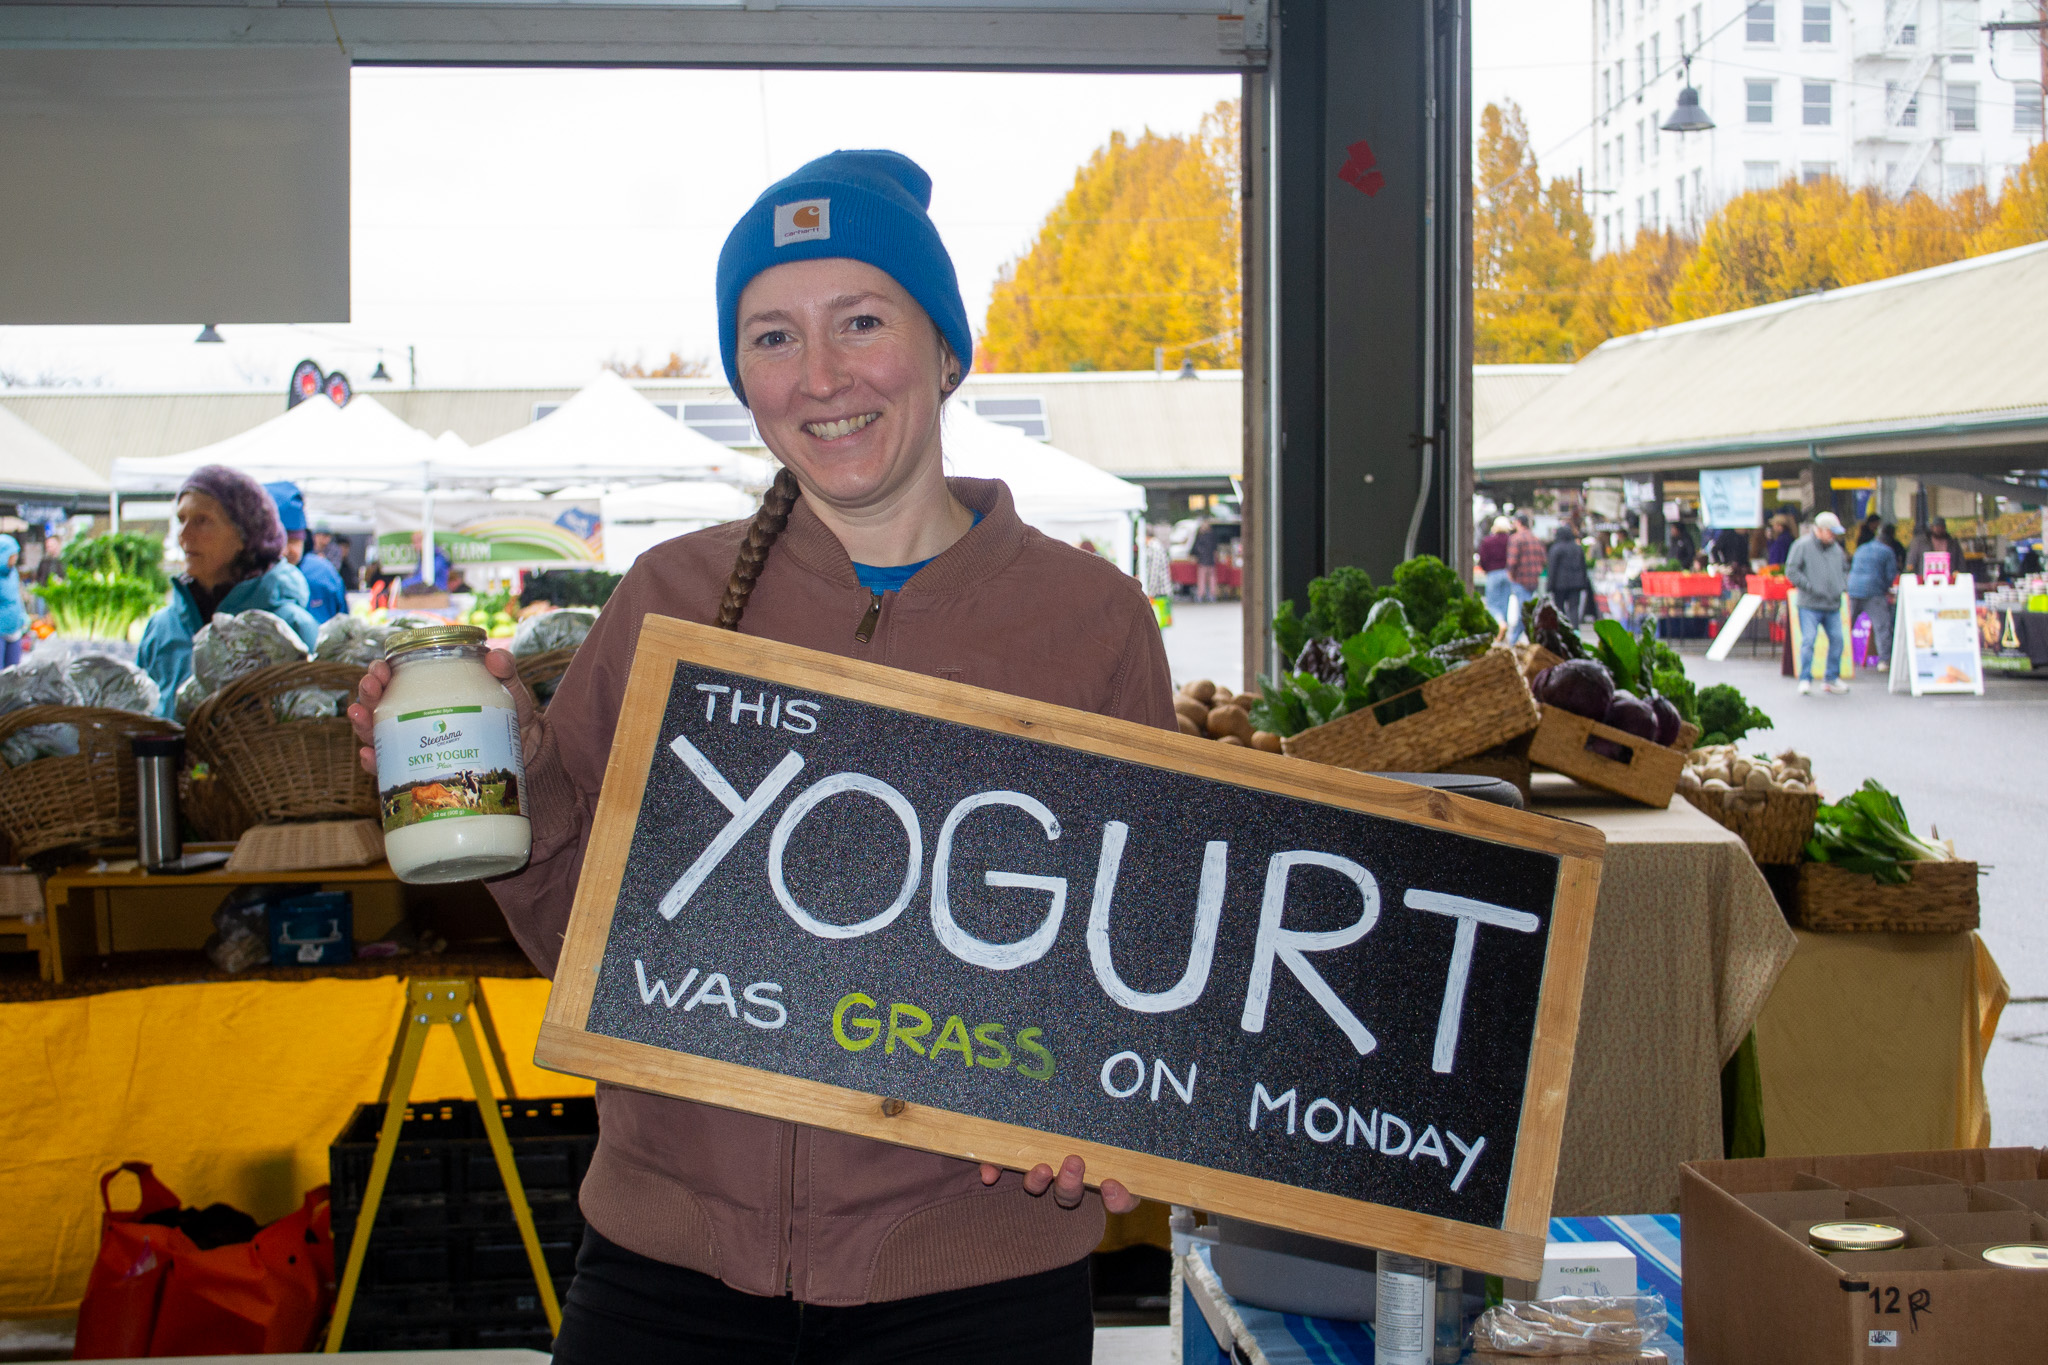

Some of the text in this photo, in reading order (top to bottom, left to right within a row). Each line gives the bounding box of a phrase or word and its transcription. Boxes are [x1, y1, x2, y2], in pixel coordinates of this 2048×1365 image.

[784, 227, 820, 237] carhartt
[696, 683, 822, 735] THIS
[420, 730, 463, 749] Steensma
[437, 737, 461, 747] CREAMERY
[408, 748, 480, 767] SKYR YOGURT
[436, 762, 453, 770] Plain
[658, 734, 1539, 1074] YOGURT
[634, 958, 1486, 1192] WAS GRASS ON MONDAY
[1869, 1286, 1901, 1314] 12
